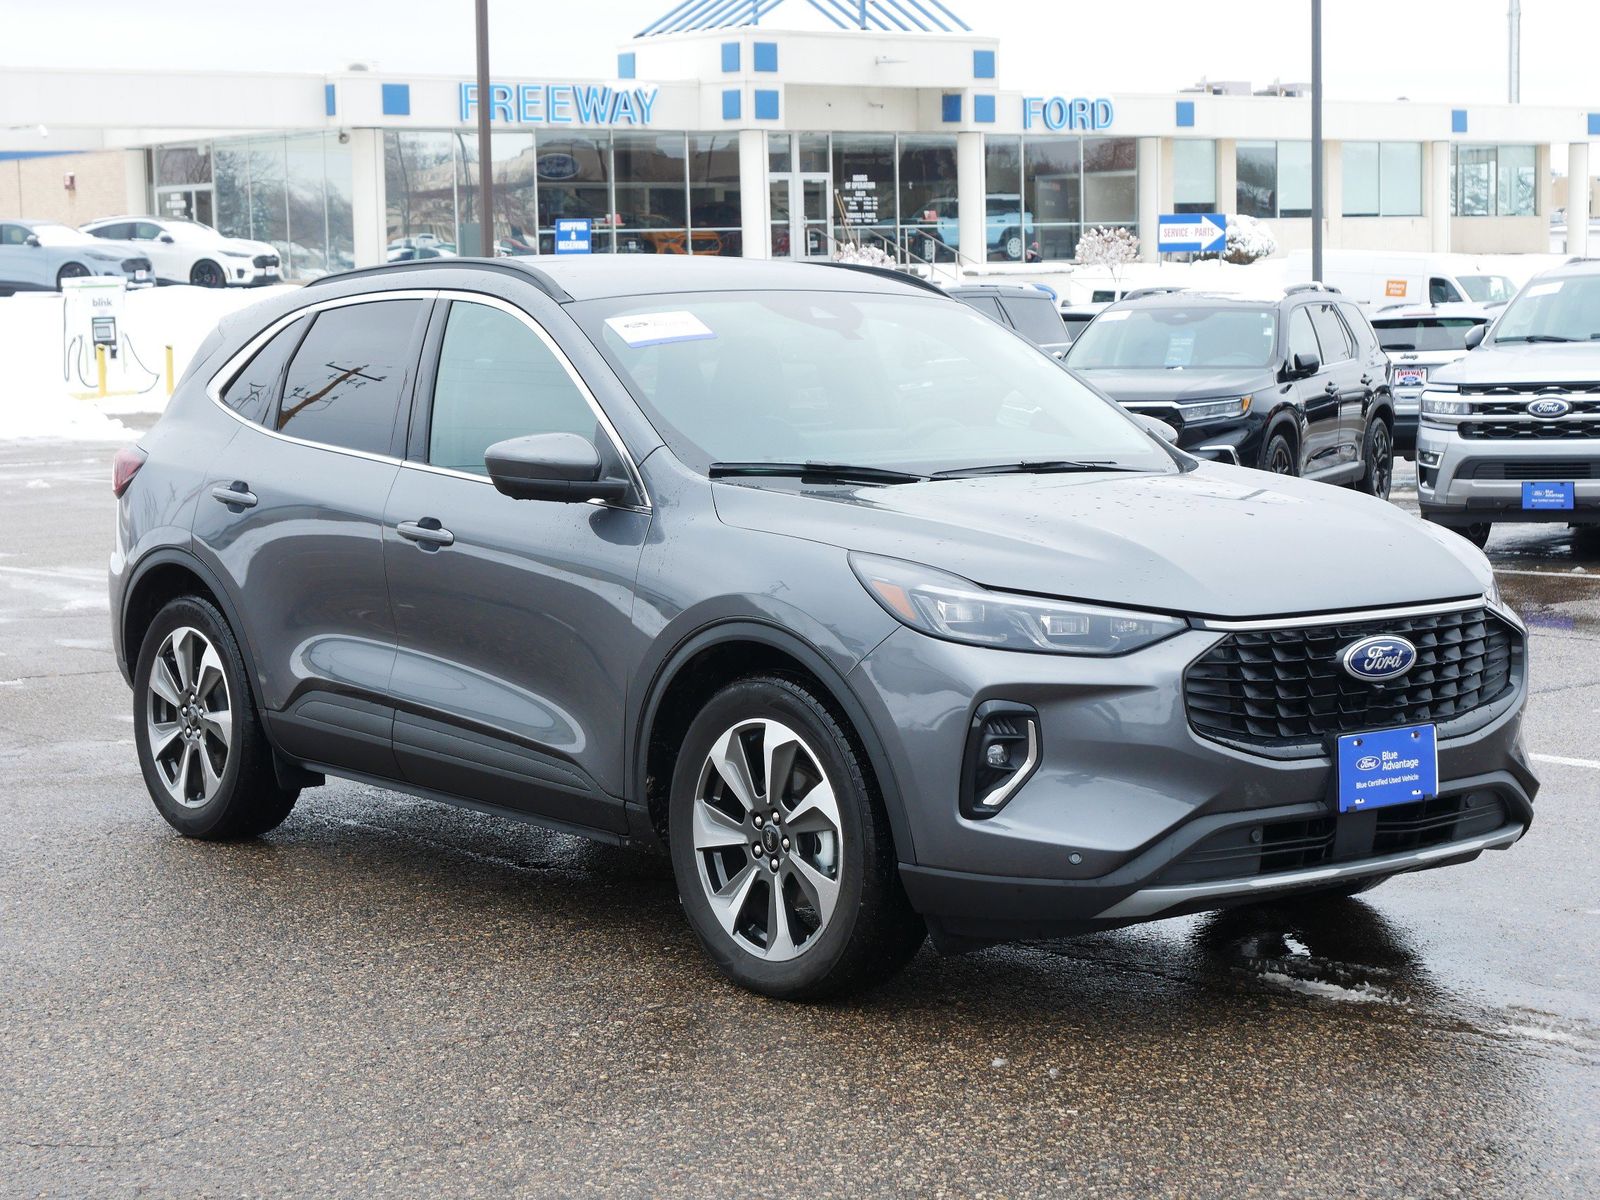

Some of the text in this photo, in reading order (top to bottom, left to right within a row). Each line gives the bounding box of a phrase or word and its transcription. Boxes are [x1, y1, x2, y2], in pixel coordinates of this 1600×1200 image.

[459, 82, 659, 124] FREEWAY
[1022, 96, 1114, 131] FORD
[1163, 227, 1189, 239] SERVICE
[1195, 227, 1215, 237] PARTS
[92, 297, 112, 307] blink
[1397, 370, 1424, 379] FREEWAY
[1537, 402, 1559, 412] Ford
[1364, 645, 1403, 671] Ford
[1360, 751, 1398, 769] Ford Blue
[1382, 759, 1419, 771] Advantage
[1367, 778, 1388, 787] Certified
[1389, 776, 1401, 784] Used
[1401, 774, 1419, 782] Vehicle
